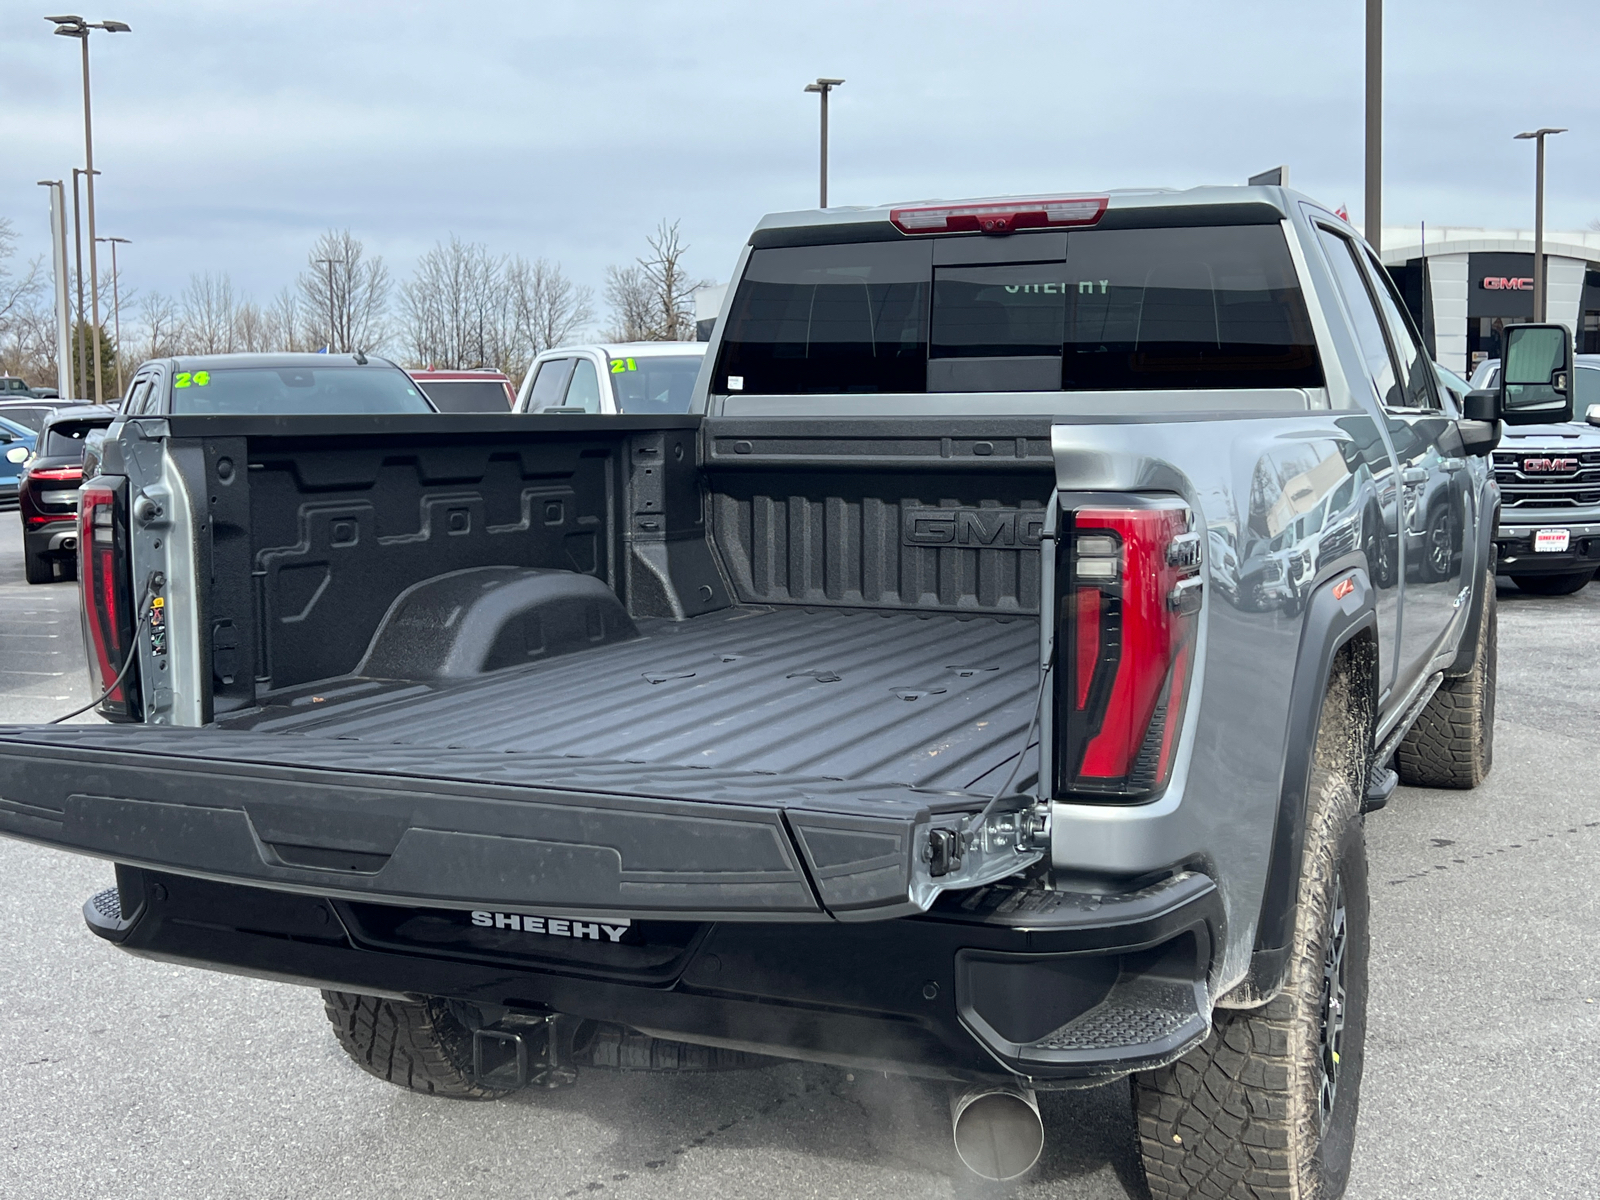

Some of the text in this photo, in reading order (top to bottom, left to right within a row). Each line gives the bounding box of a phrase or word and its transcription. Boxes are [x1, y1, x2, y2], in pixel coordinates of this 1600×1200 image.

[1483, 276, 1534, 290] GMC
[610, 357, 637, 373] 21
[175, 370, 210, 388] 24
[1523, 458, 1578, 471] GMC
[471, 910, 628, 942] SHEEHY
